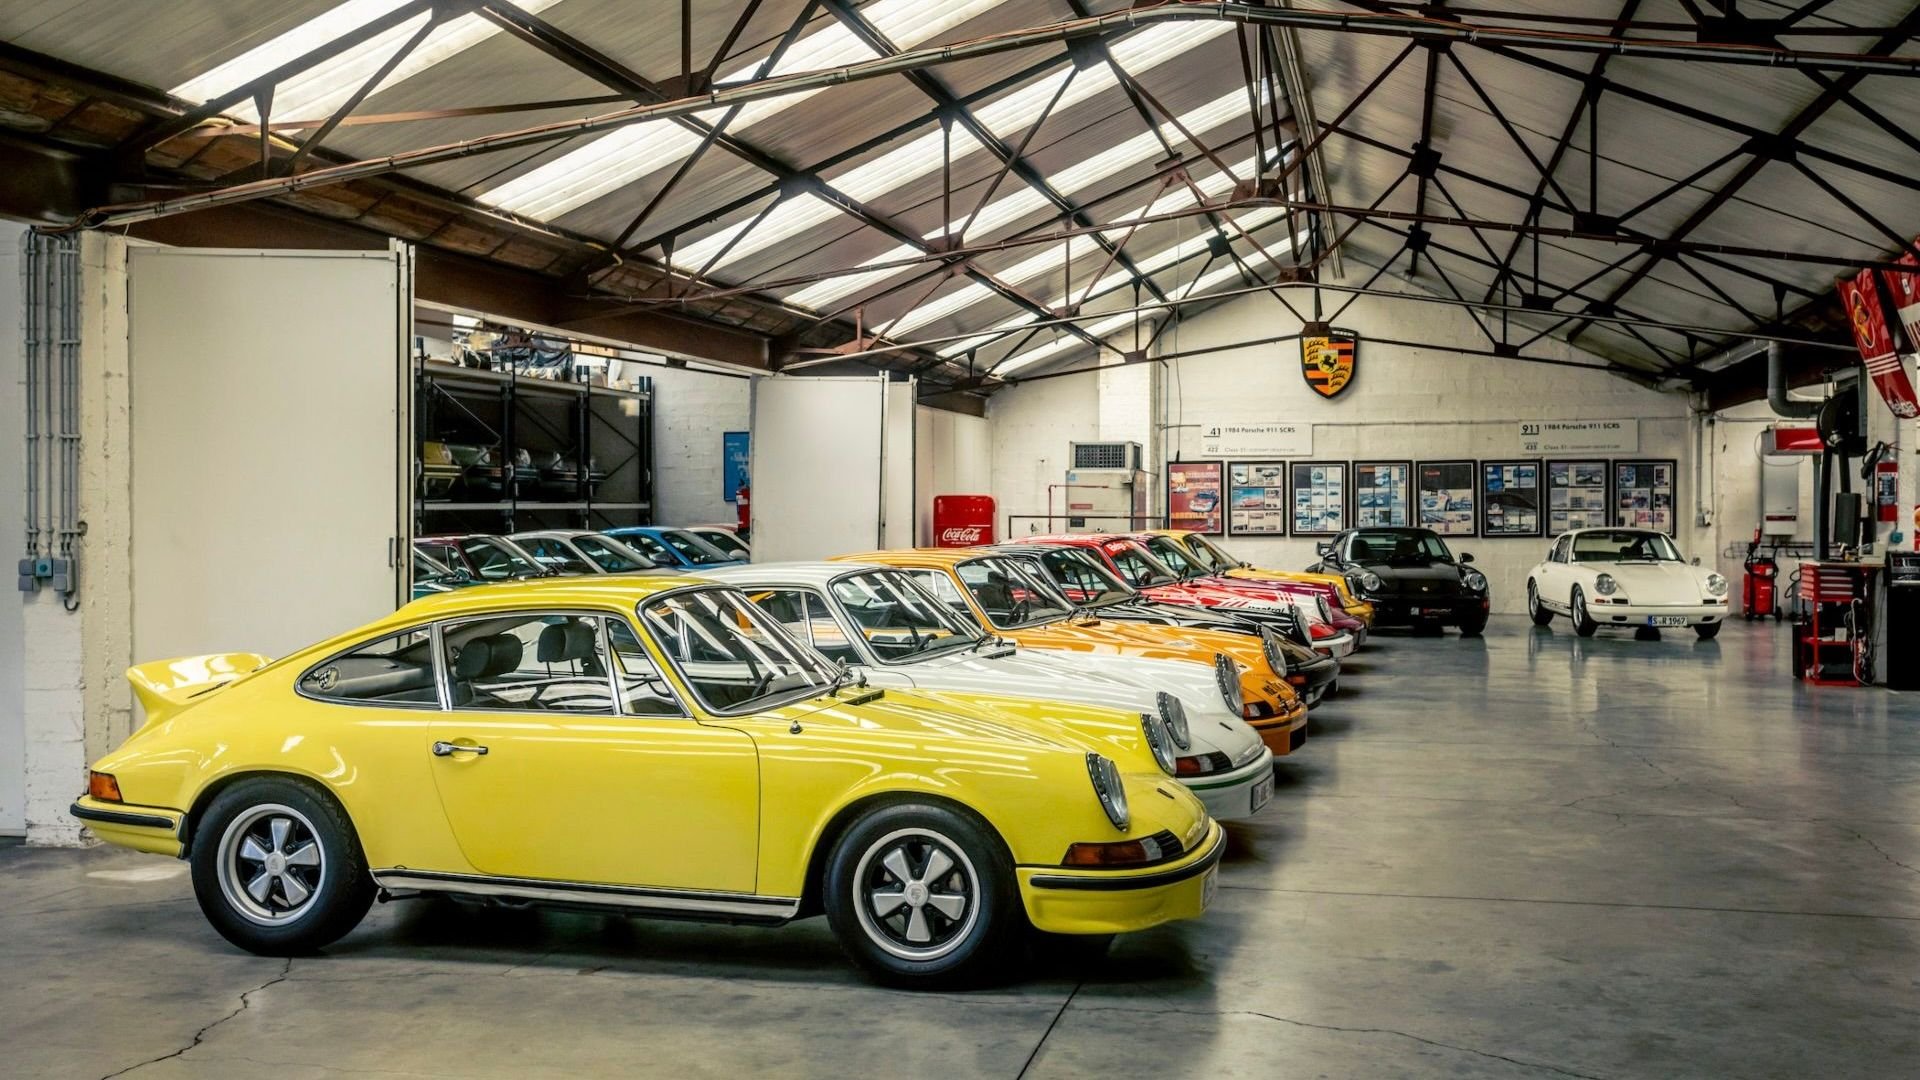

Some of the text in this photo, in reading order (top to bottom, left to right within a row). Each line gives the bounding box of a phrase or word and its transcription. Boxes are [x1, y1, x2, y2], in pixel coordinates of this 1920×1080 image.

[1210, 427, 1221, 436] 41
[1522, 424, 1540, 434] 911
[942, 527, 982, 542] Coca-Cola
[1669, 616, 1686, 625] 1967
